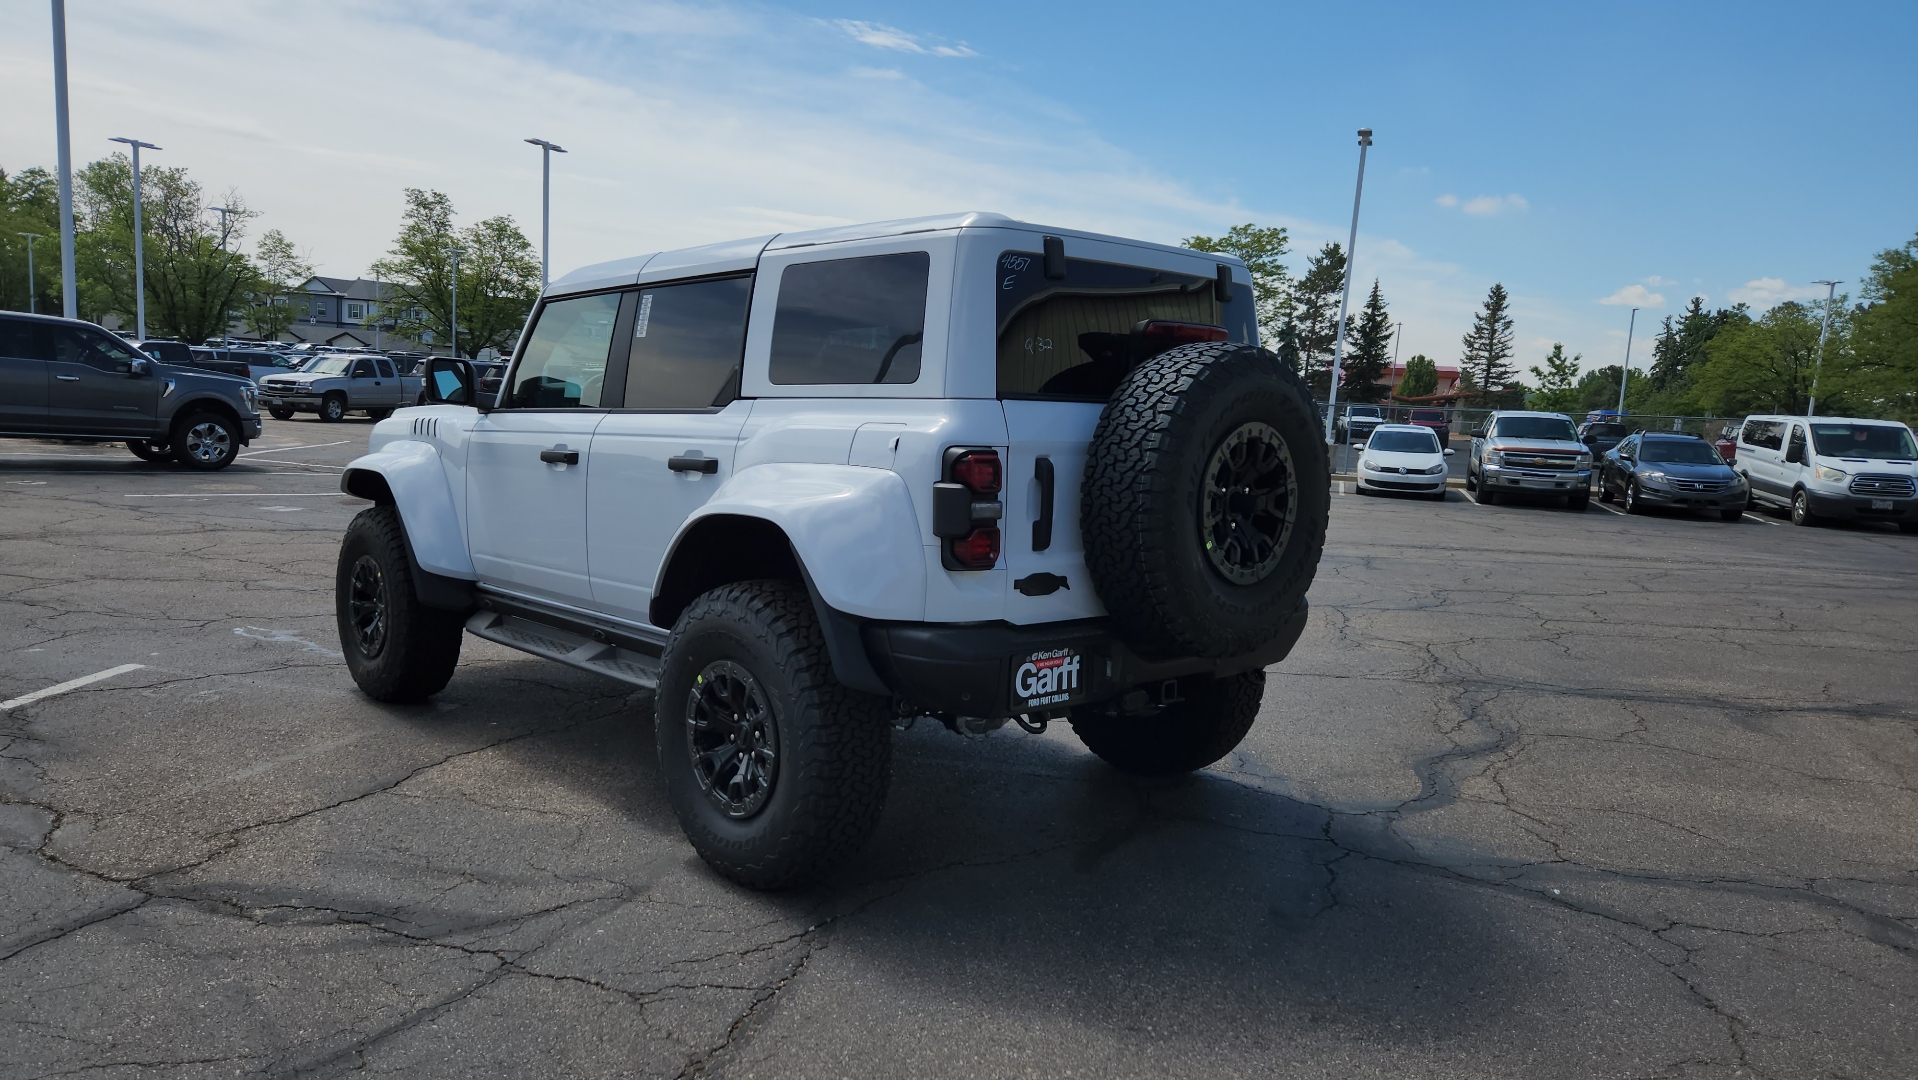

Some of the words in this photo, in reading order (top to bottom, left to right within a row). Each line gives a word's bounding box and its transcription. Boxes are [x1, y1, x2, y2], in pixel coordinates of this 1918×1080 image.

[1002, 274, 1016, 290] E
[1037, 650, 1052, 660] Ken
[1051, 648, 1069, 658] Garff
[1015, 655, 1080, 698] Garff
[1028, 697, 1040, 708] FORD
